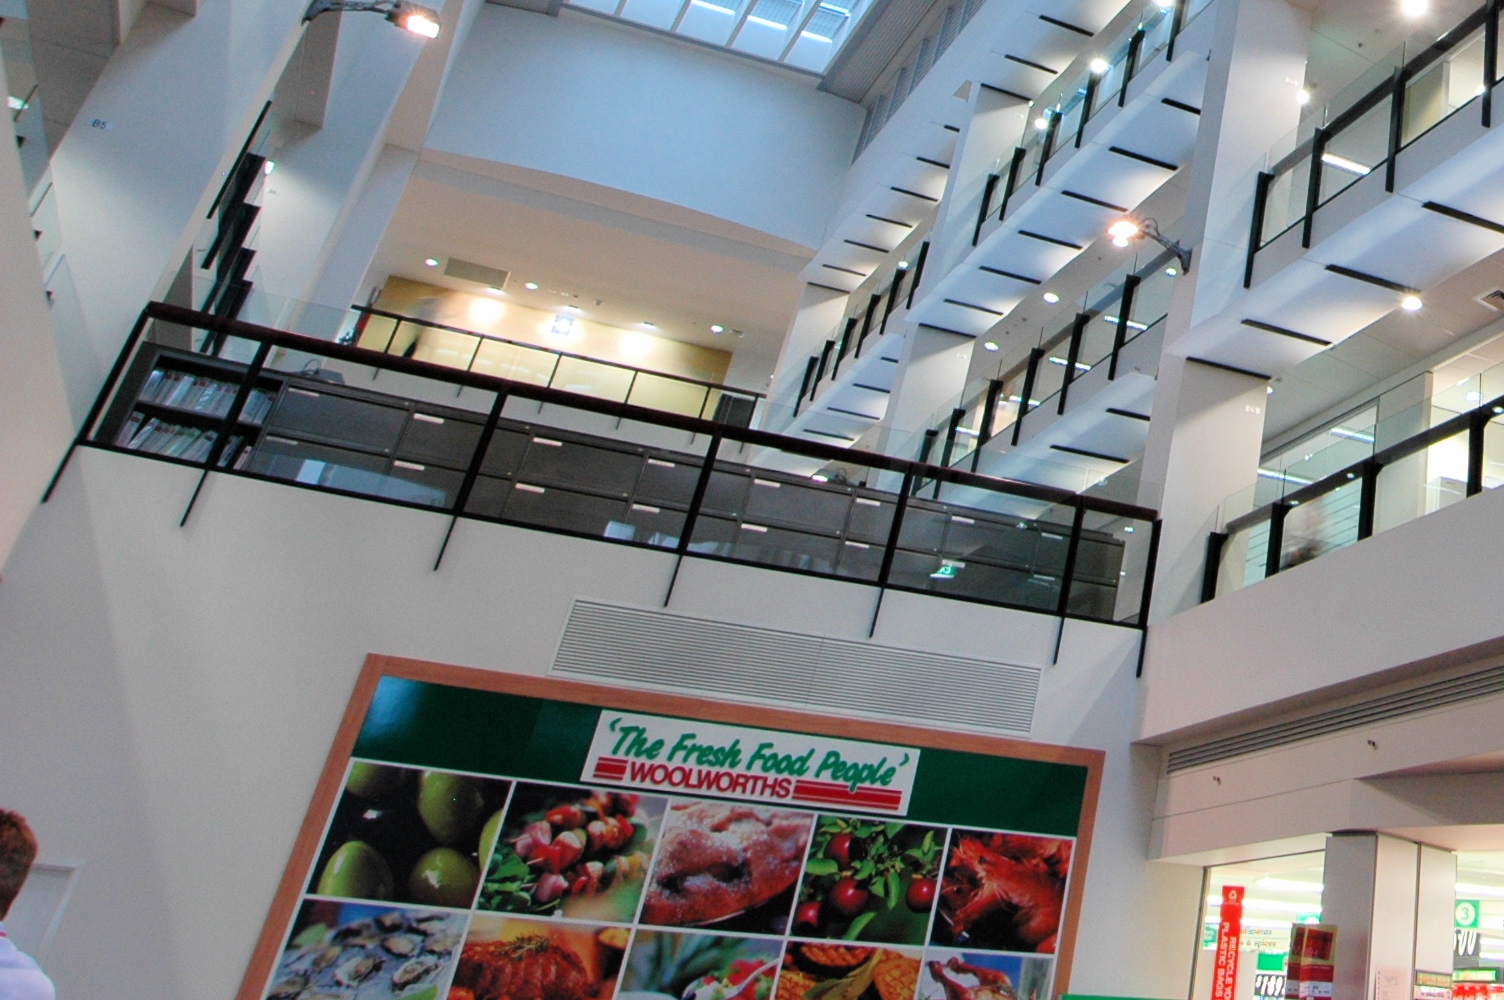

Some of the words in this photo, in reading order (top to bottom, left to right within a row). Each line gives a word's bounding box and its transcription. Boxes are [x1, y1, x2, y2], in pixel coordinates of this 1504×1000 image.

[667, 733, 742, 769] Fresh
[746, 742, 815, 777] Food
[629, 761, 792, 799] WOOLWORTHS
[1461, 907, 1470, 920] 3
[1218, 921, 1230, 965] PLASTIC
[1225, 936, 1237, 985] RECYCLE
[1215, 967, 1225, 998] BAGS
